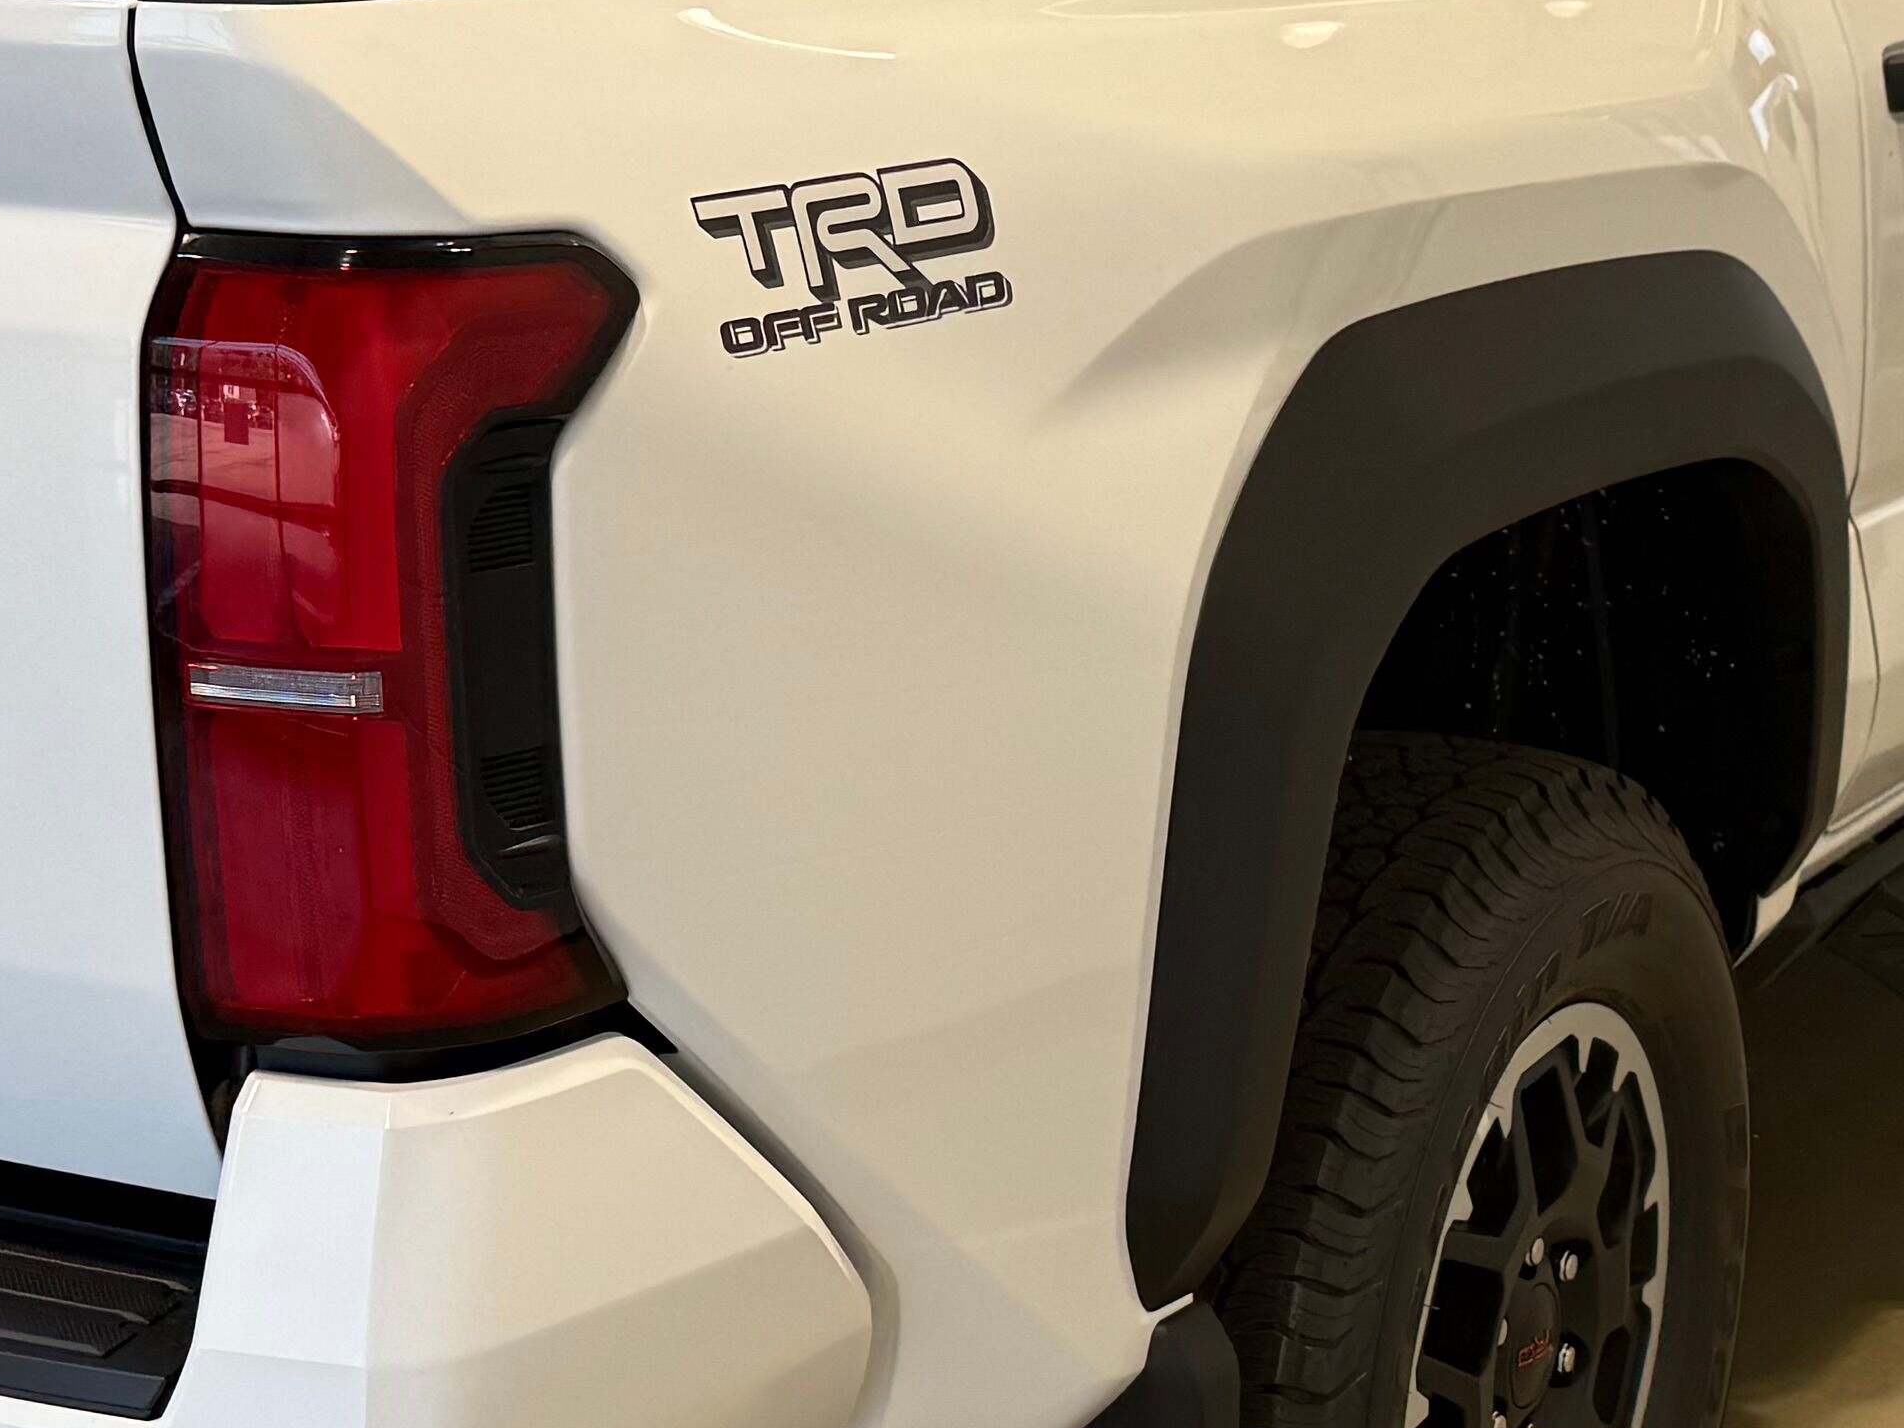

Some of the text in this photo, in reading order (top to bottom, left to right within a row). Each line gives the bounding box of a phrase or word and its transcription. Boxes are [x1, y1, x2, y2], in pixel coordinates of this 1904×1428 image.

[690, 157, 996, 302] TRD
[719, 270, 1014, 359] OFF ROAD
